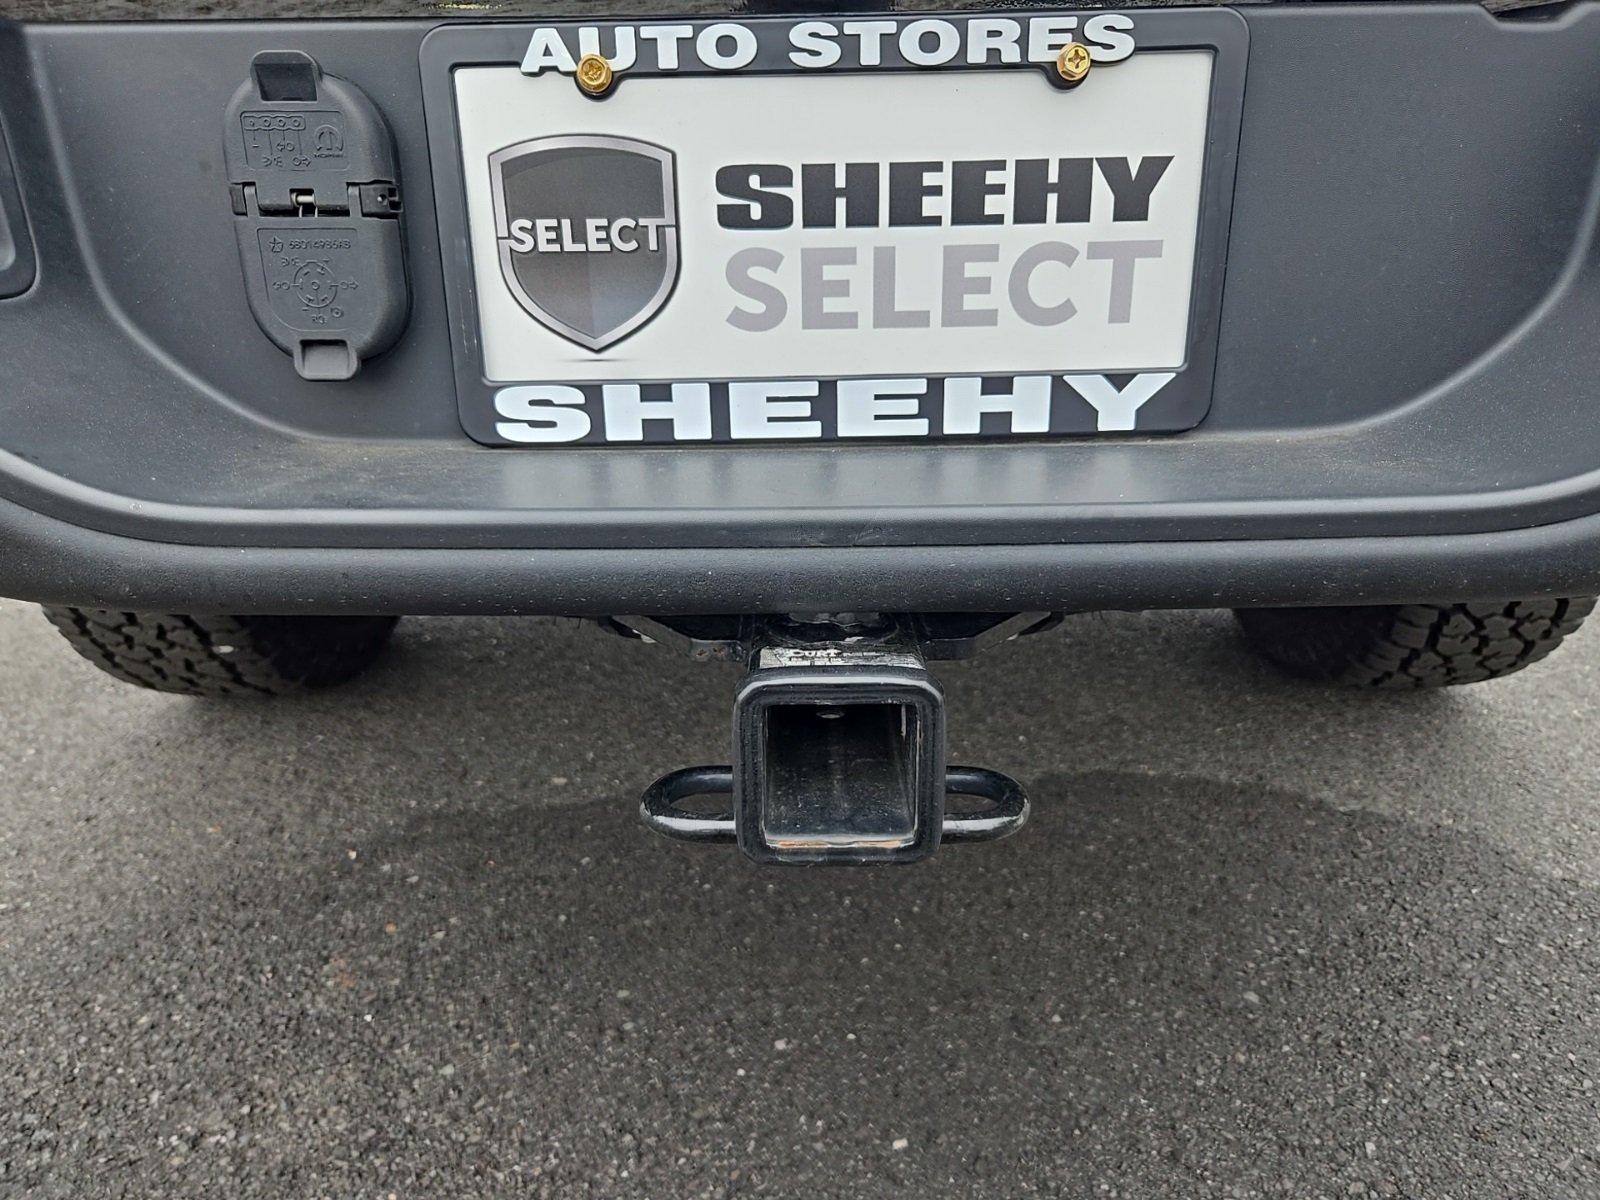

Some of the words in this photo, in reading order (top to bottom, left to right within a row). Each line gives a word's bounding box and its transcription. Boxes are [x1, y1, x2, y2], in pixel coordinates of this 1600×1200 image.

[521, 26, 758, 74] AUTO
[788, 15, 1136, 68] STORES
[715, 156, 1175, 230] SHEEHY
[507, 217, 665, 253] SELECT
[725, 239, 1164, 332] SELECT
[494, 373, 1176, 443] SHEEHY
